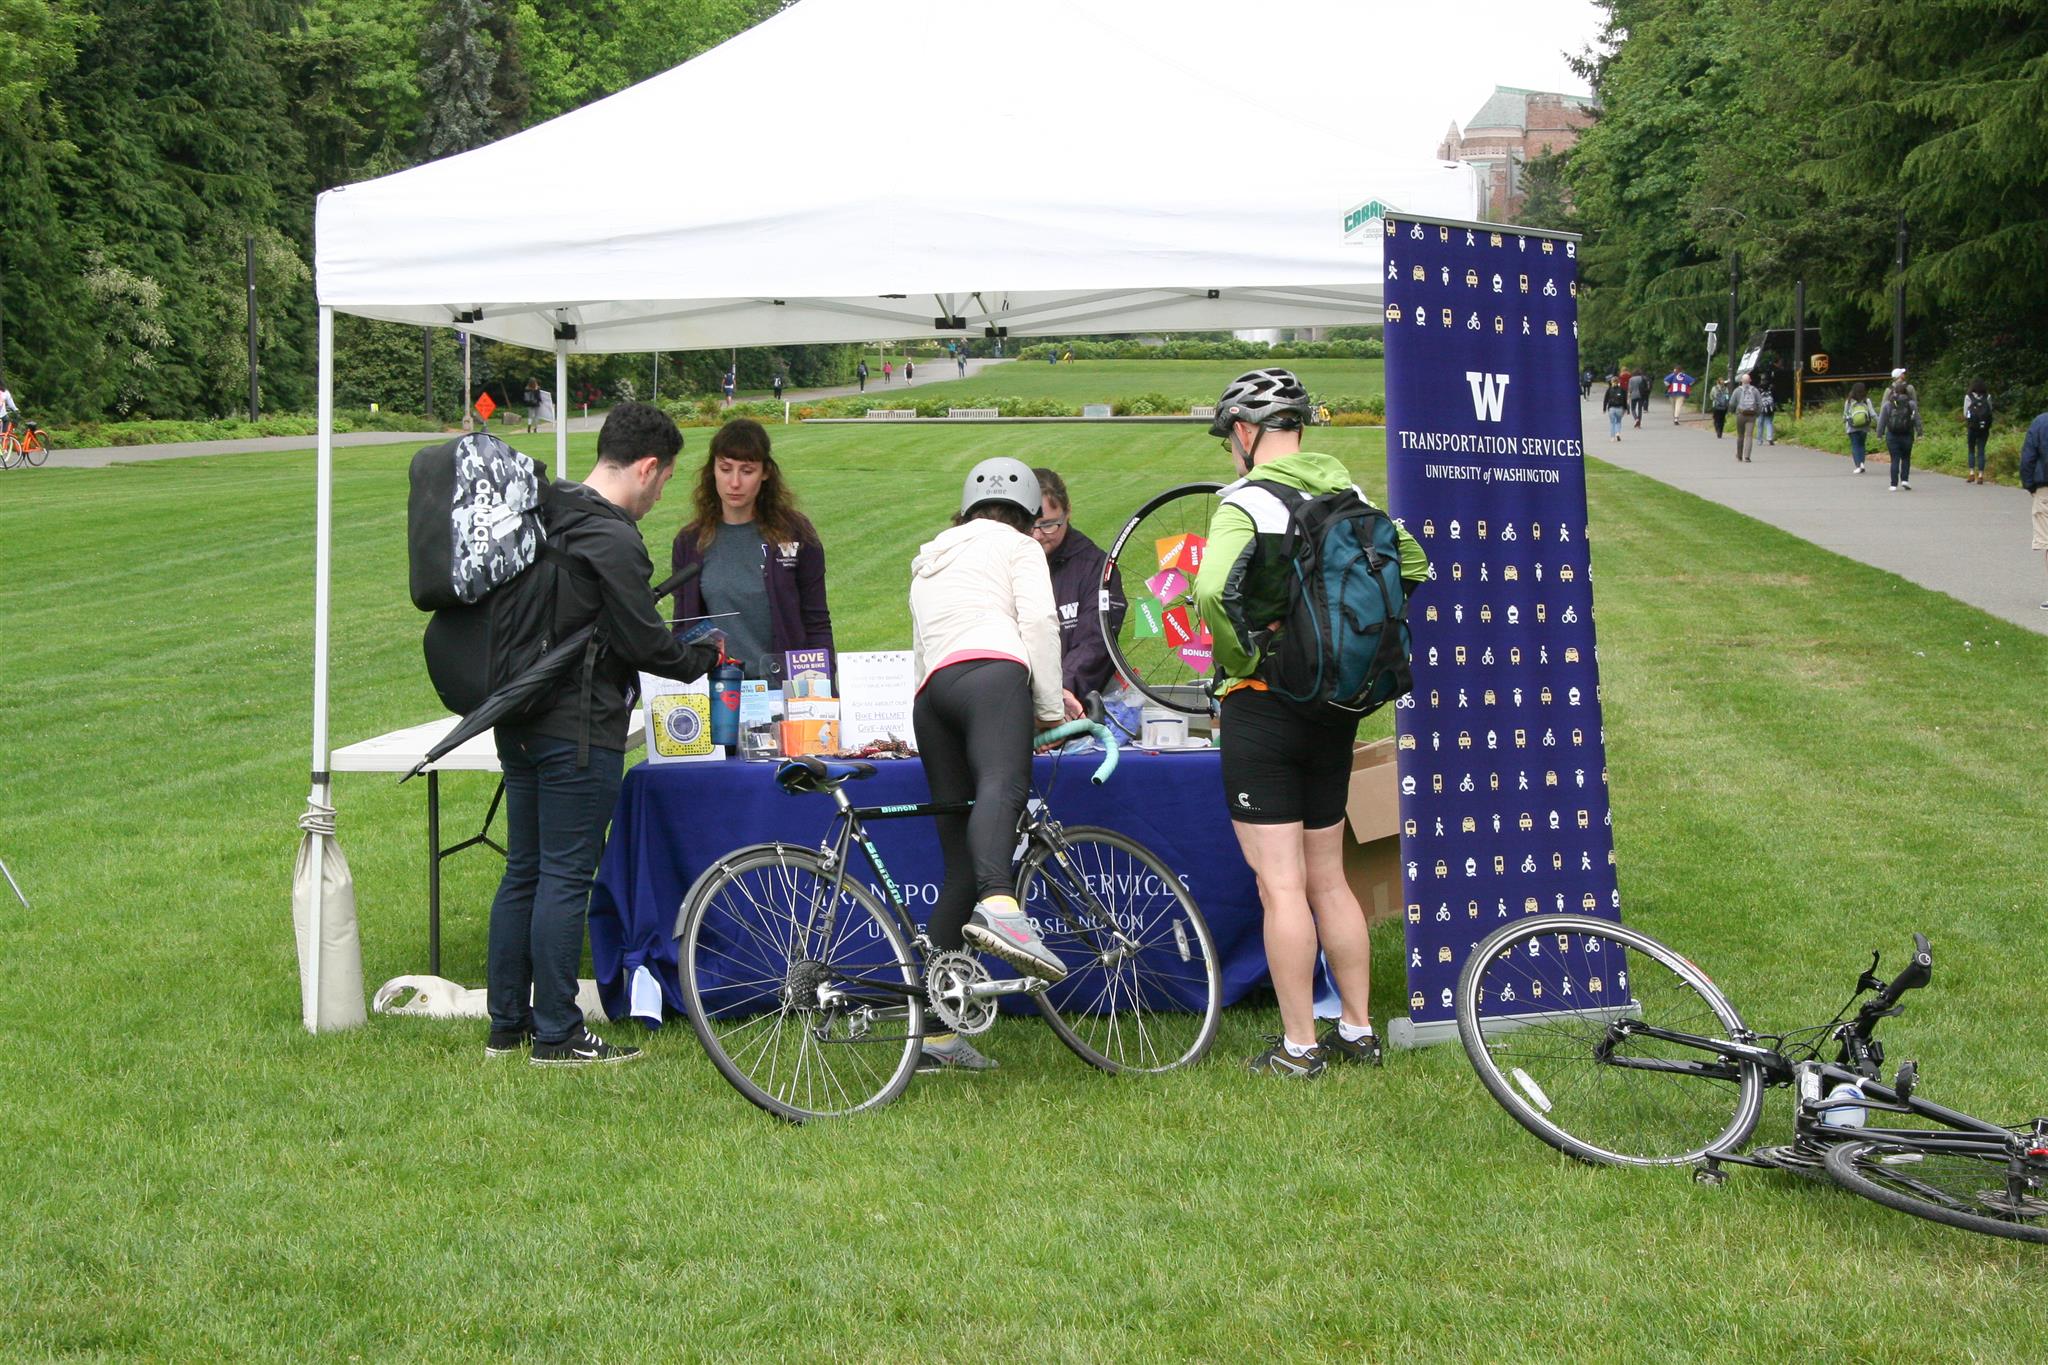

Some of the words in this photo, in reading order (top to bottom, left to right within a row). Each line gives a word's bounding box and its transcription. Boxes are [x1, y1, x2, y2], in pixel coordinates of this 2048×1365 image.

[1344, 200, 1388, 233] CARAV
[1466, 371, 1510, 422] W
[1399, 431, 1518, 455] TRANSPORTATION
[1521, 437, 1582, 457] SERVICES
[1425, 464, 1482, 480] UNIVERSITY
[1483, 468, 1492, 484] of
[1494, 467, 1560, 483] WASHINGTON
[473, 479, 493, 554] adidas
[1190, 545, 1199, 566] BIKE
[1159, 573, 1176, 598] WALK
[1059, 602, 1080, 620] W
[1166, 613, 1191, 643] TRANSIT
[792, 652, 825, 664] LOVE
[855, 712, 873, 720] BIKE
[874, 711, 906, 720] HELMET
[858, 723, 905, 733] GIVE-AWAY!
[881, 804, 918, 814] Bianchi
[865, 841, 904, 904] Bianchi
[1070, 874, 1190, 897] ERVICES
